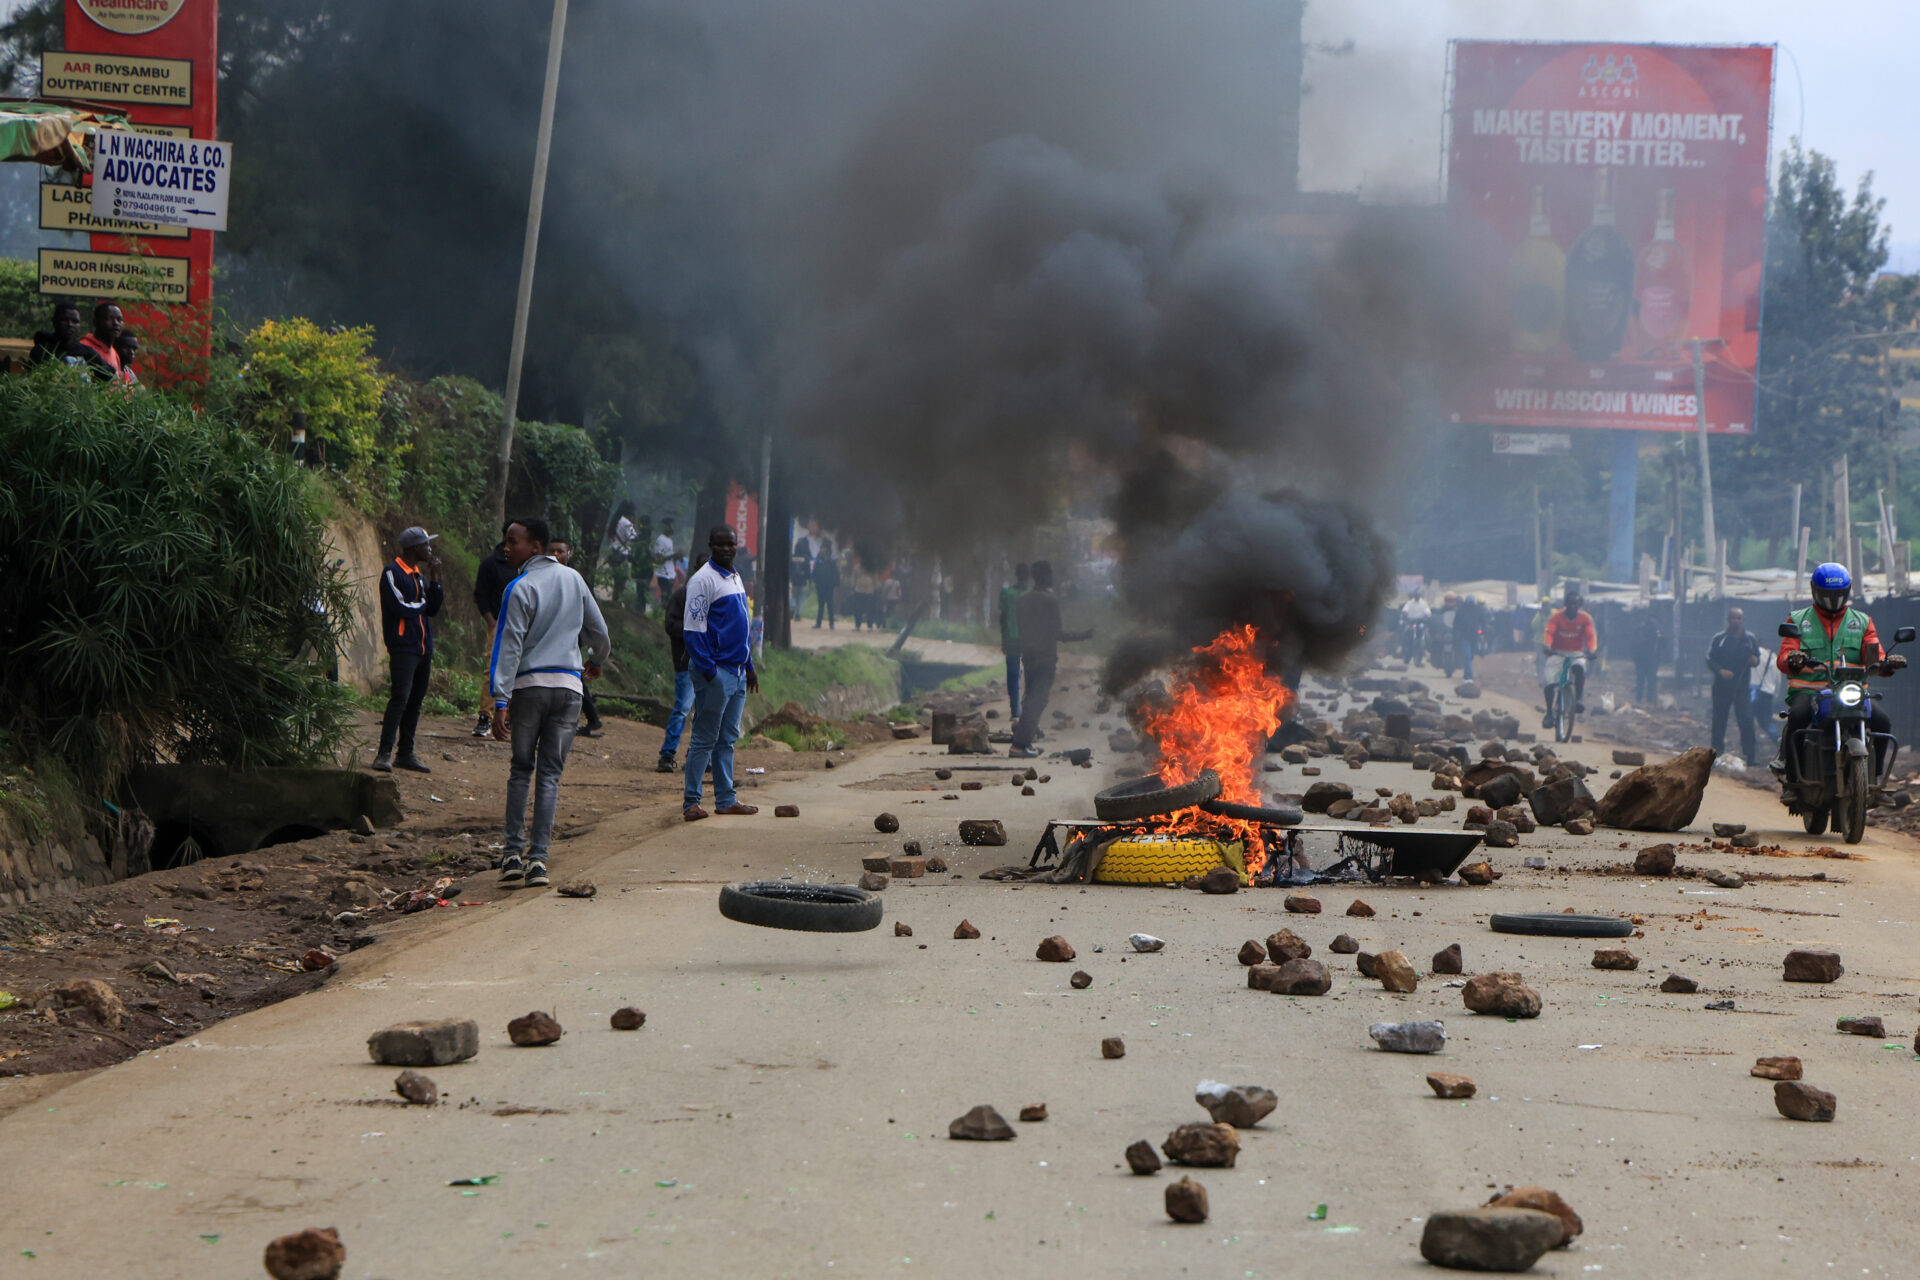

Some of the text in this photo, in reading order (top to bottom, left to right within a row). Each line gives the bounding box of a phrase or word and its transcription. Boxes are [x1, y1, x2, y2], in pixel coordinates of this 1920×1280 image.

[109, 11, 134, 19] humn
[63, 61, 170, 79] AAR ROYSAMBU
[47, 78, 187, 98] OUTPATIENT CENTRE
[1472, 109, 1746, 145] MAKE EVERY MOMENT,
[99, 133, 224, 169] L N WACHIRA & CO.
[1515, 136, 1706, 168] TASTE BETTER...
[102, 158, 216, 194] ADVOCATES
[122, 200, 176, 214] 0794049616
[53, 259, 175, 278] MAJOR INSURACE
[41, 274, 184, 295] PROVIDERS ACCEPTED
[1495, 387, 1698, 417] WITH ASCONI WINES
